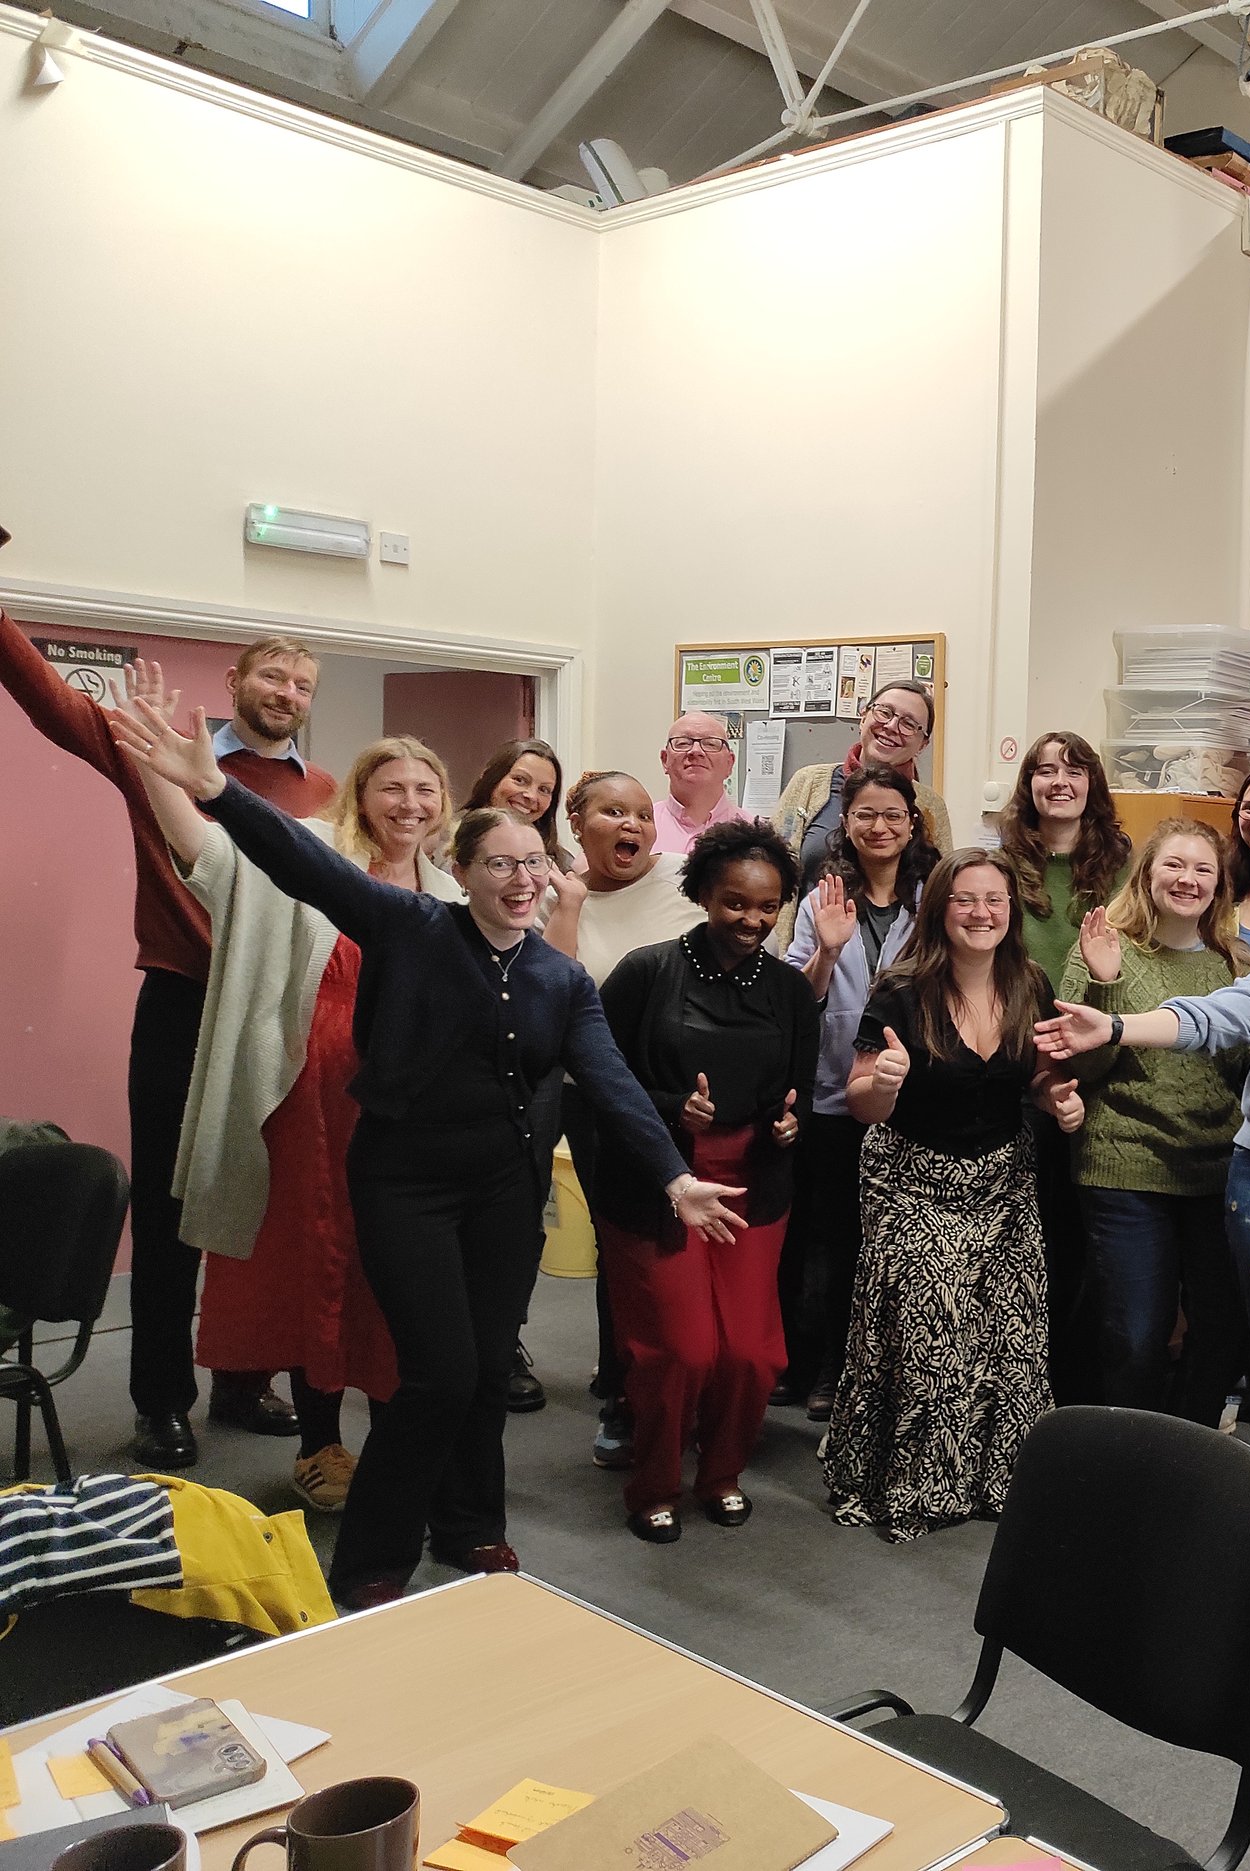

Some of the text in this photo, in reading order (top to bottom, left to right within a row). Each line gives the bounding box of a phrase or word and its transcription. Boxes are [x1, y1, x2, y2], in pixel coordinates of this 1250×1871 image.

[47, 644, 122, 664] No Smoking
[687, 660, 739, 671] The Environment
